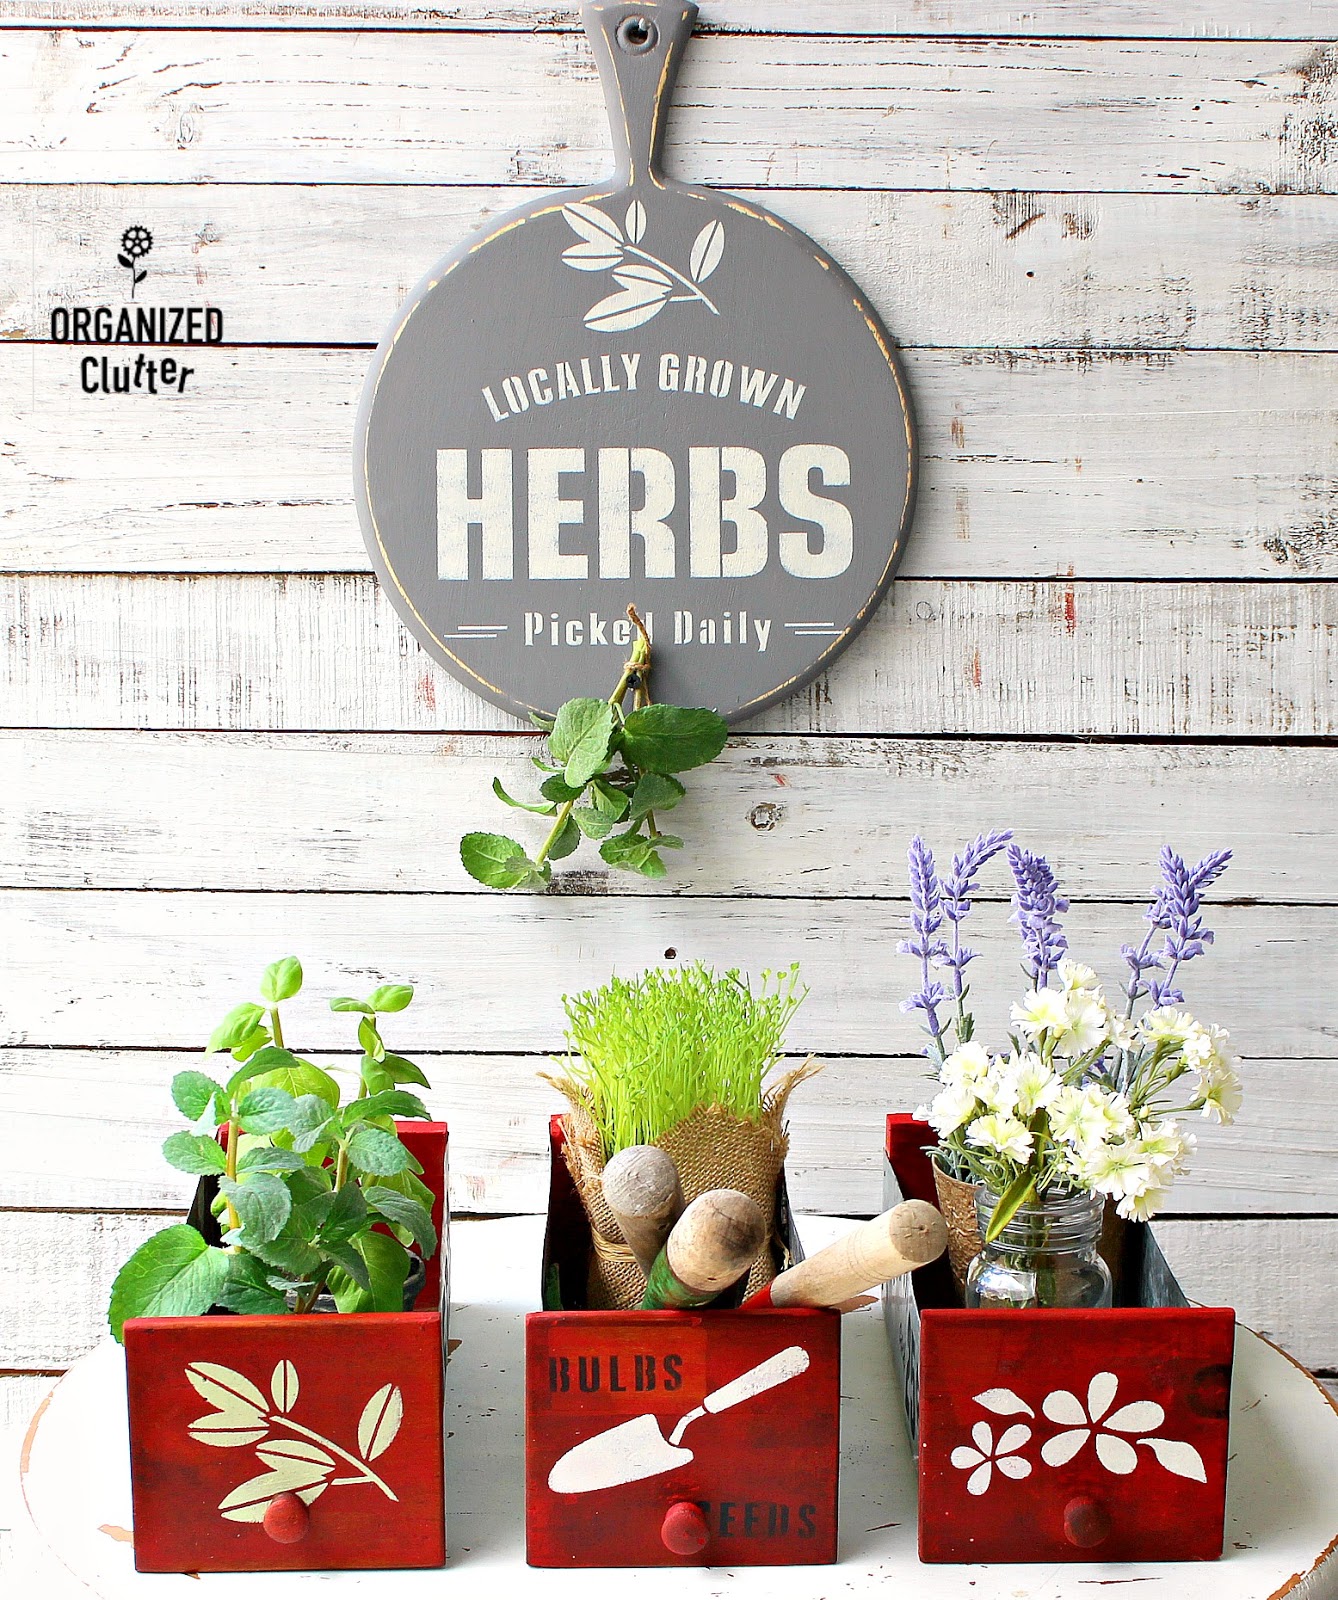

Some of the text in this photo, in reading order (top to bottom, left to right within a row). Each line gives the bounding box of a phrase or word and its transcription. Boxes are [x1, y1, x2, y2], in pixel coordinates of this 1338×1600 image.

[481, 353, 807, 422] LOCALLY GROWN
[436, 443, 853, 580] HERBS
[674, 610, 772, 652] Daily
[549, 1353, 683, 1392] BULBS
[698, 1501, 816, 1538] EEDS
